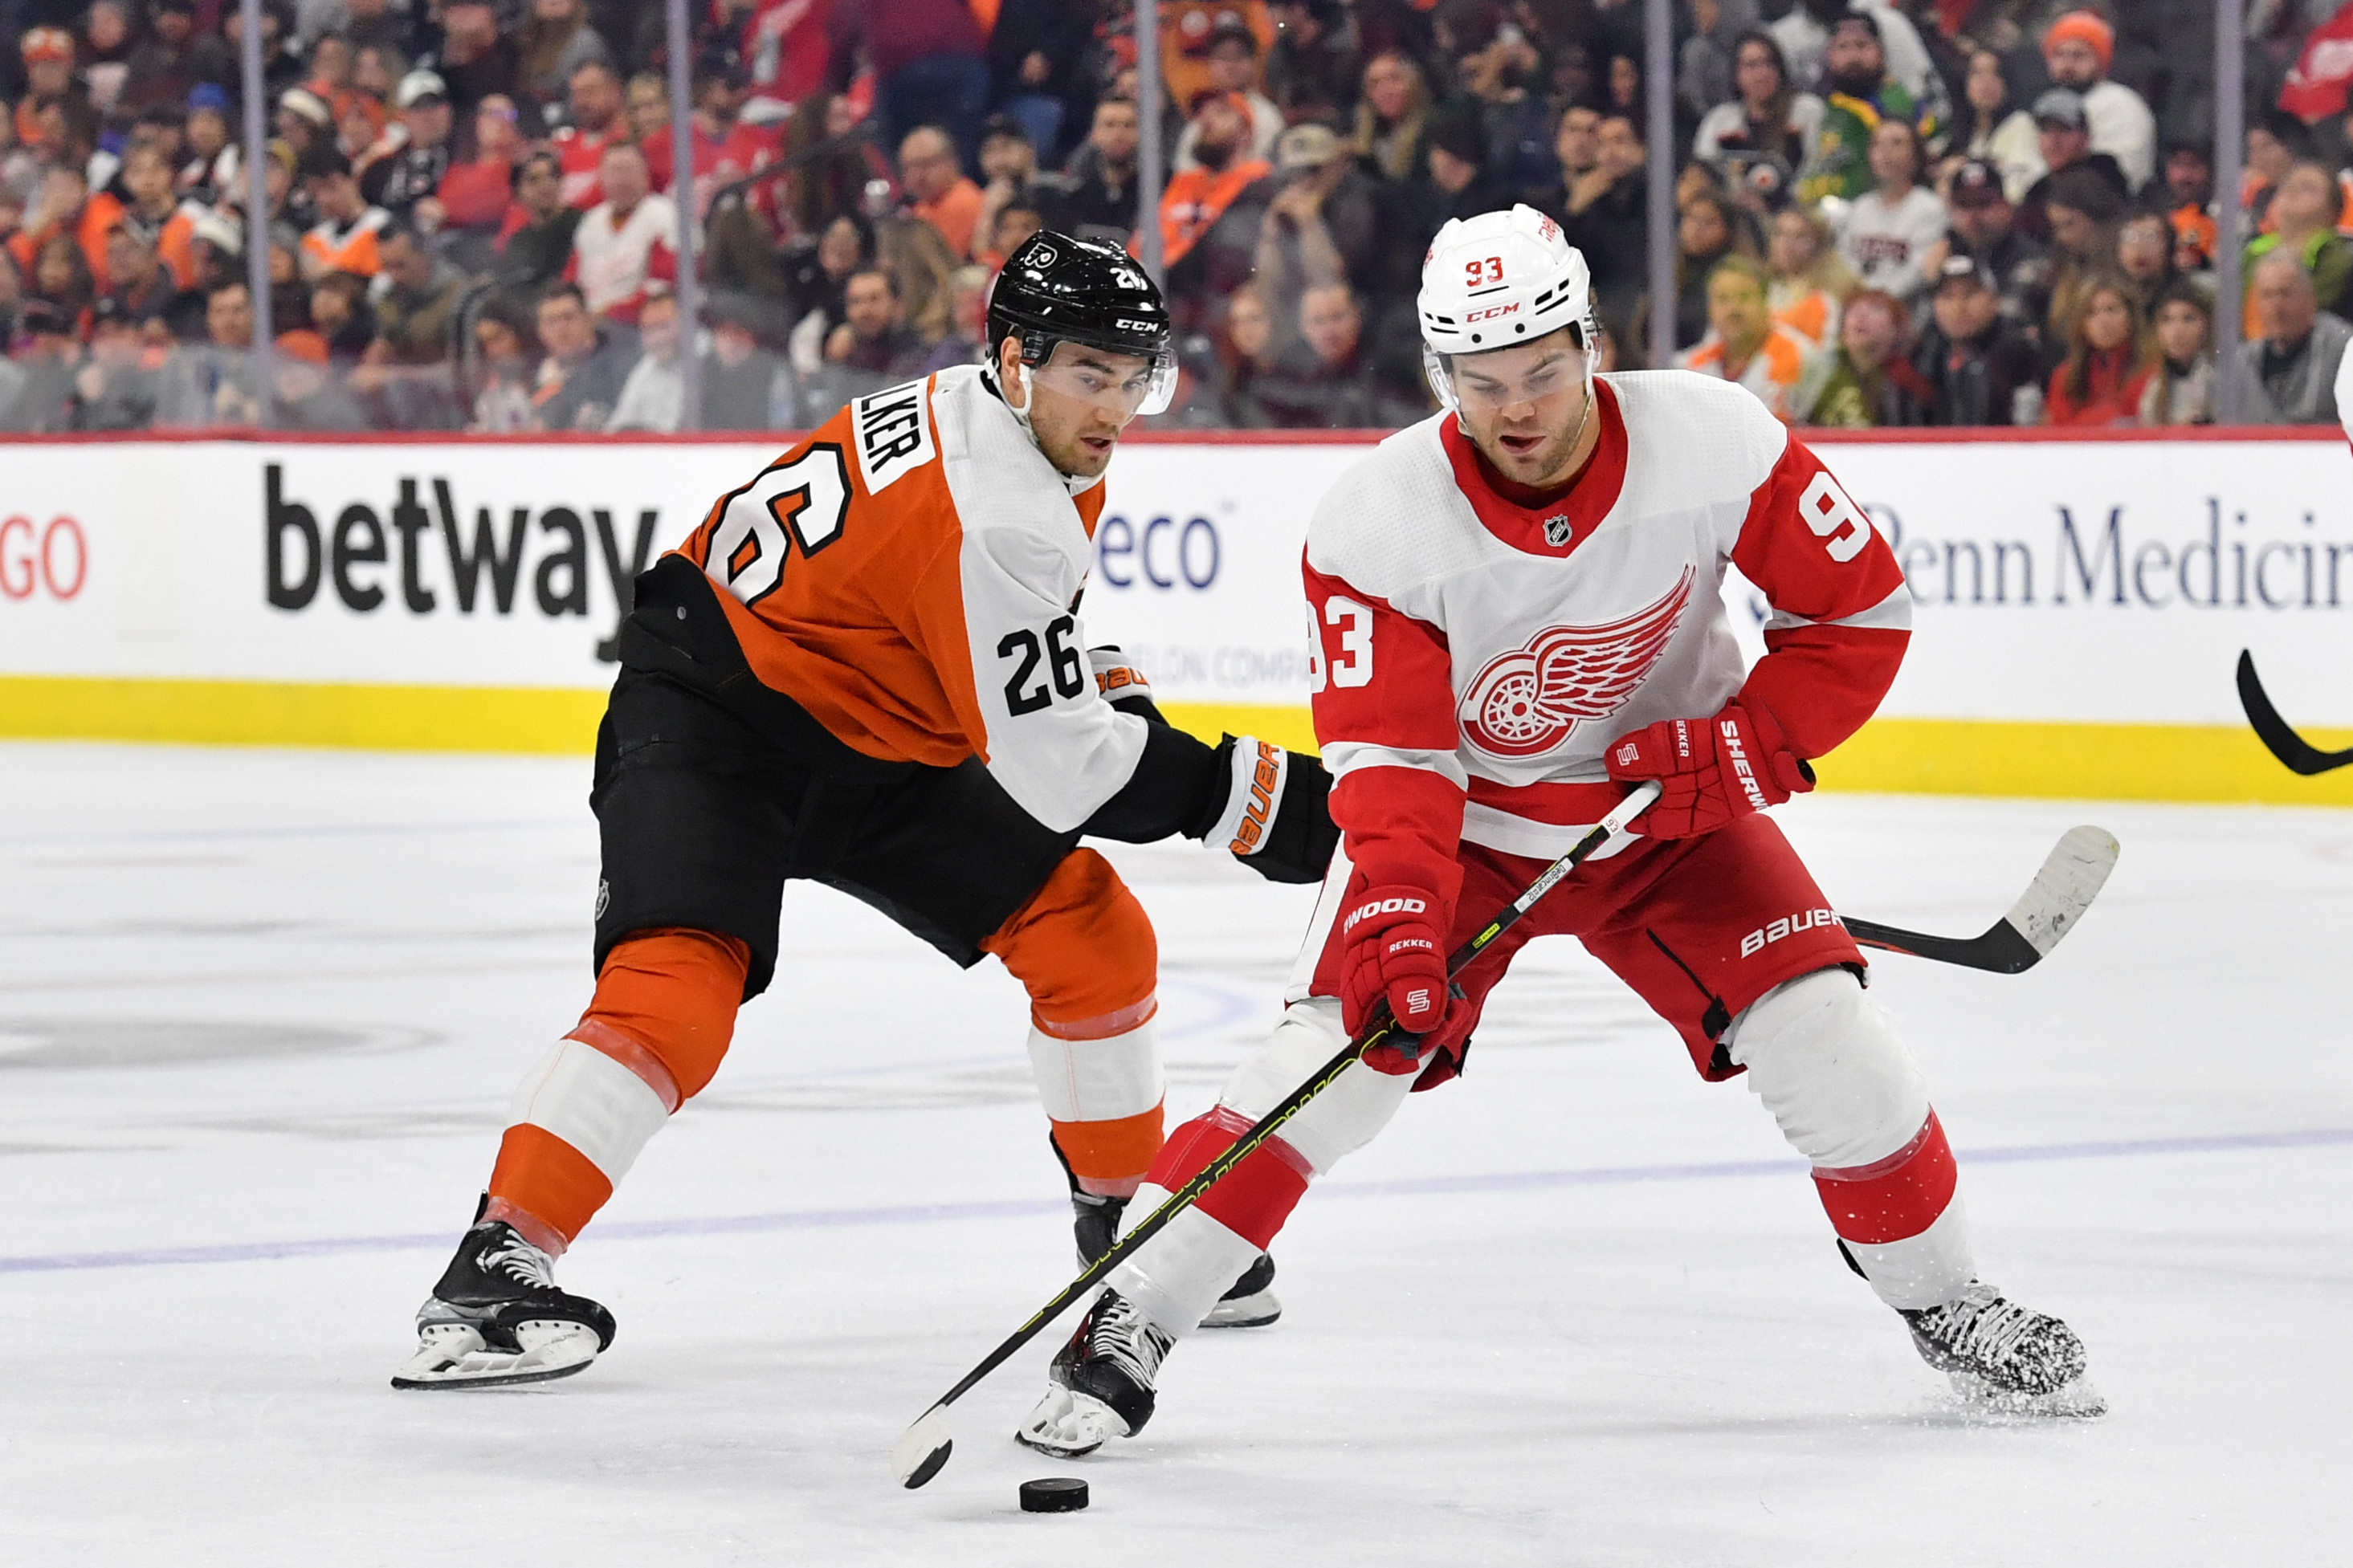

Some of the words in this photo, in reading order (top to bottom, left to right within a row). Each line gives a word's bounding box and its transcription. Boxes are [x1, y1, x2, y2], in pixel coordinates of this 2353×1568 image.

[1466, 256, 1503, 287] 93
[1115, 318, 1159, 332] CCM
[1466, 303, 1520, 323] CCM
[704, 442, 852, 609] 6
[263, 462, 659, 663] betway
[1098, 515, 1220, 591] eco
[997, 615, 1084, 717] 26
[1605, 818, 1618, 833] 93
[1389, 939, 1433, 954] REKKER
